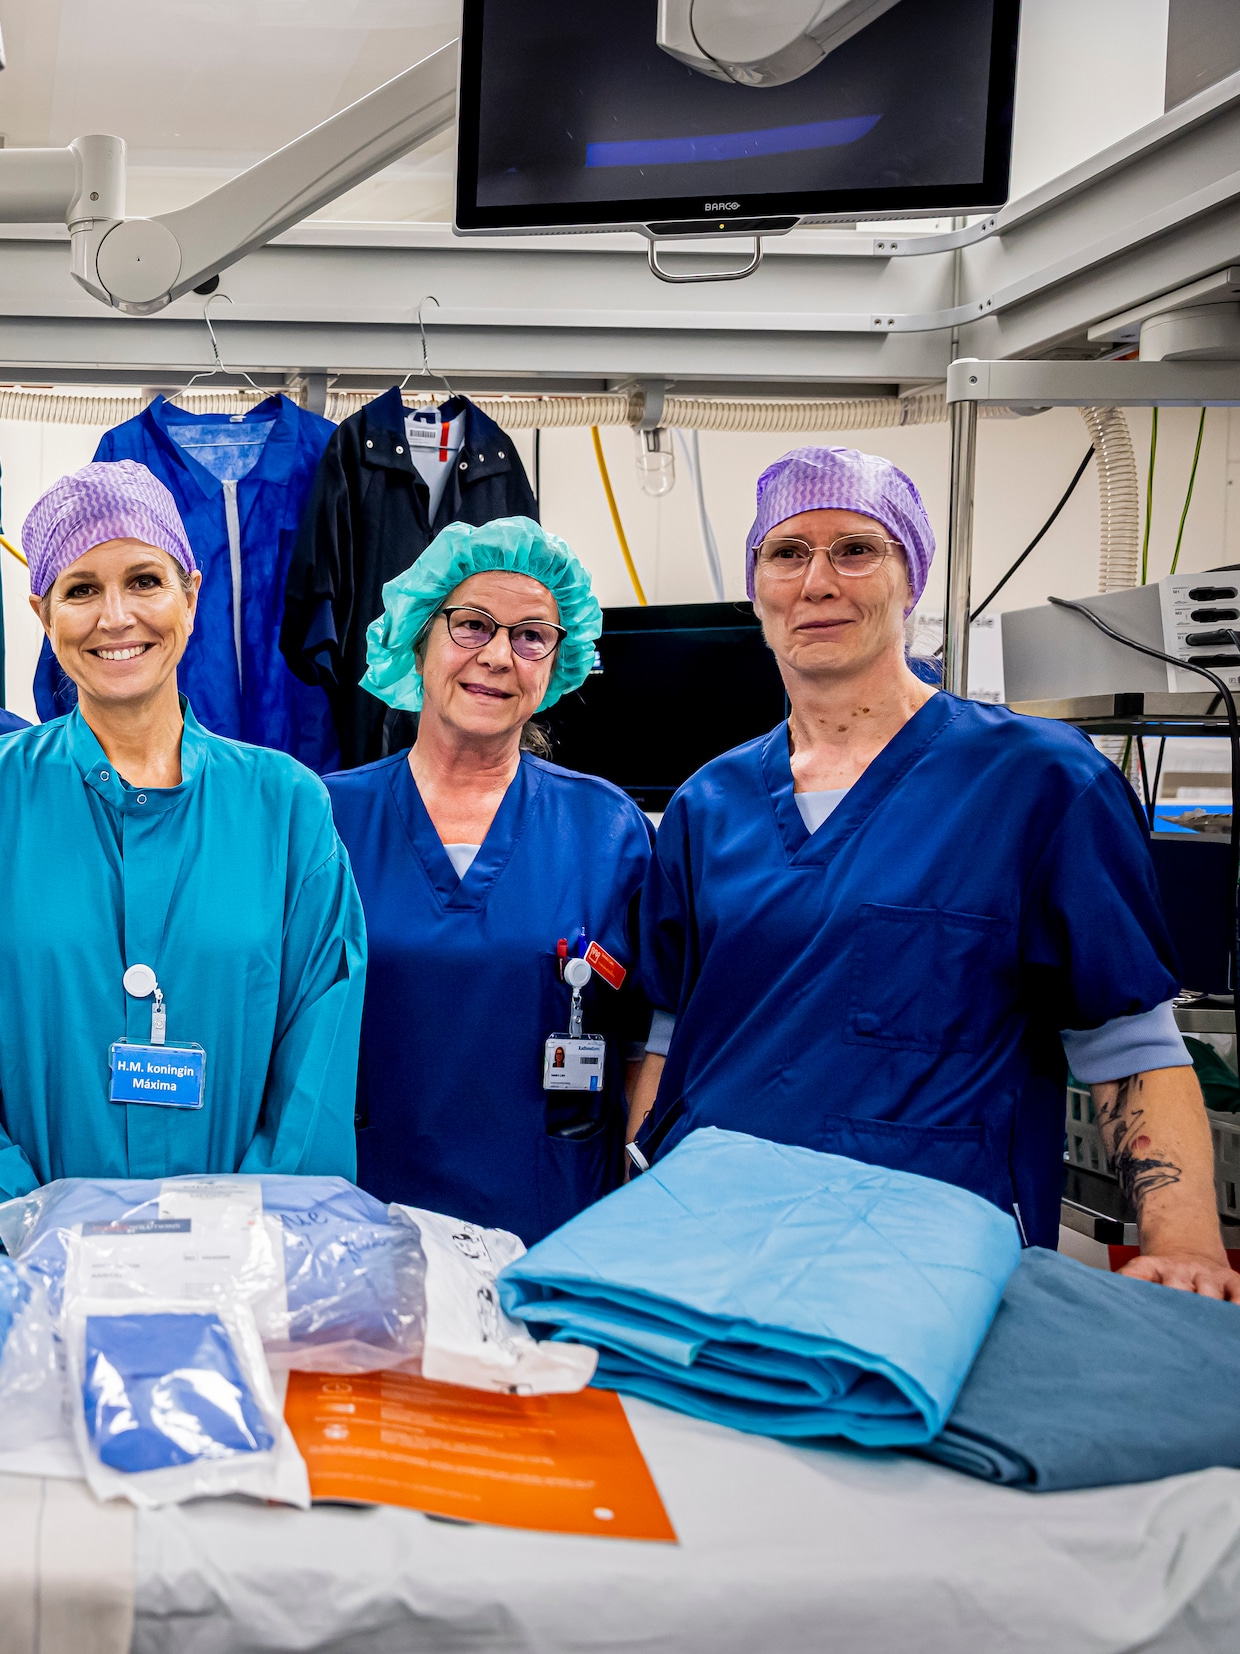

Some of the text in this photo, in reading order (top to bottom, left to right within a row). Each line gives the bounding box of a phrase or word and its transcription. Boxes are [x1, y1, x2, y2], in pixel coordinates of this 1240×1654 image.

[704, 202, 741, 212] BARCO
[117, 1060, 194, 1078] H.M. koningin
[132, 1078, 177, 1092] Máxima
